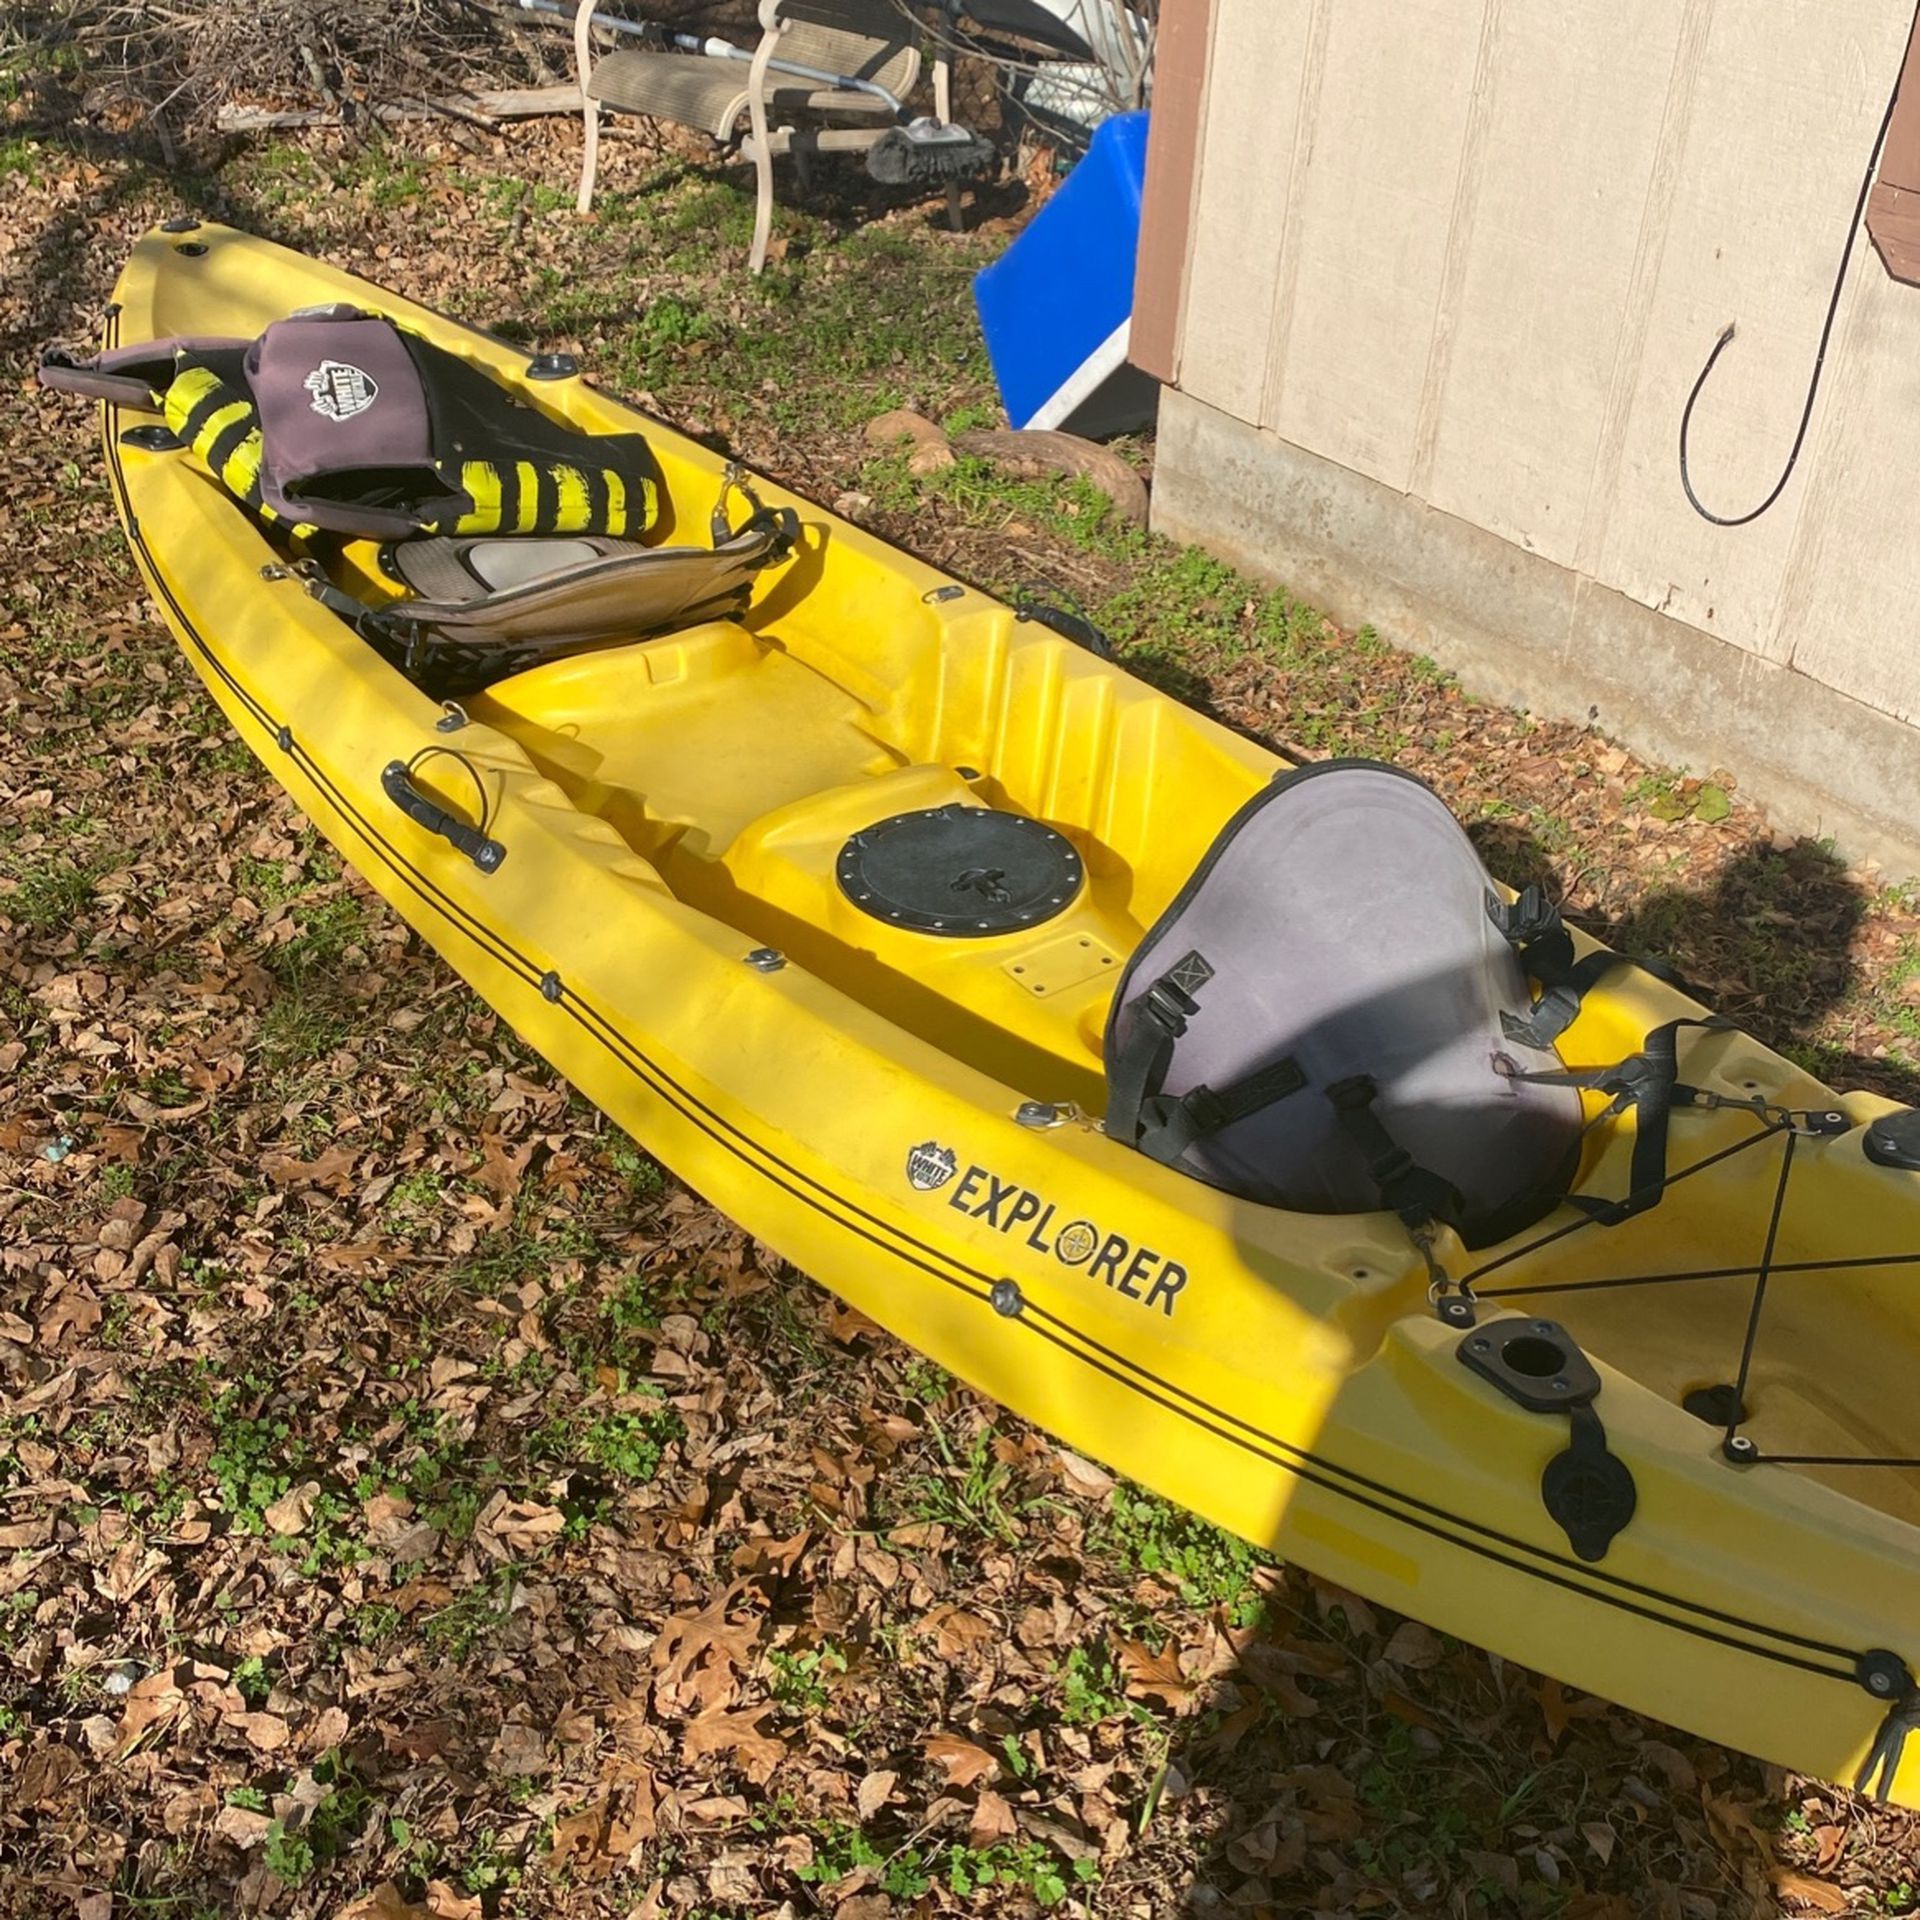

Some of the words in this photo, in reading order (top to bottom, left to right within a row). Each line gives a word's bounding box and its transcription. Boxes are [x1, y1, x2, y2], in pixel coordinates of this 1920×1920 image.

[331, 369, 356, 412] WHITE
[911, 1154, 948, 1179] WHITE
[949, 1165, 1187, 1316] EXPLORER
